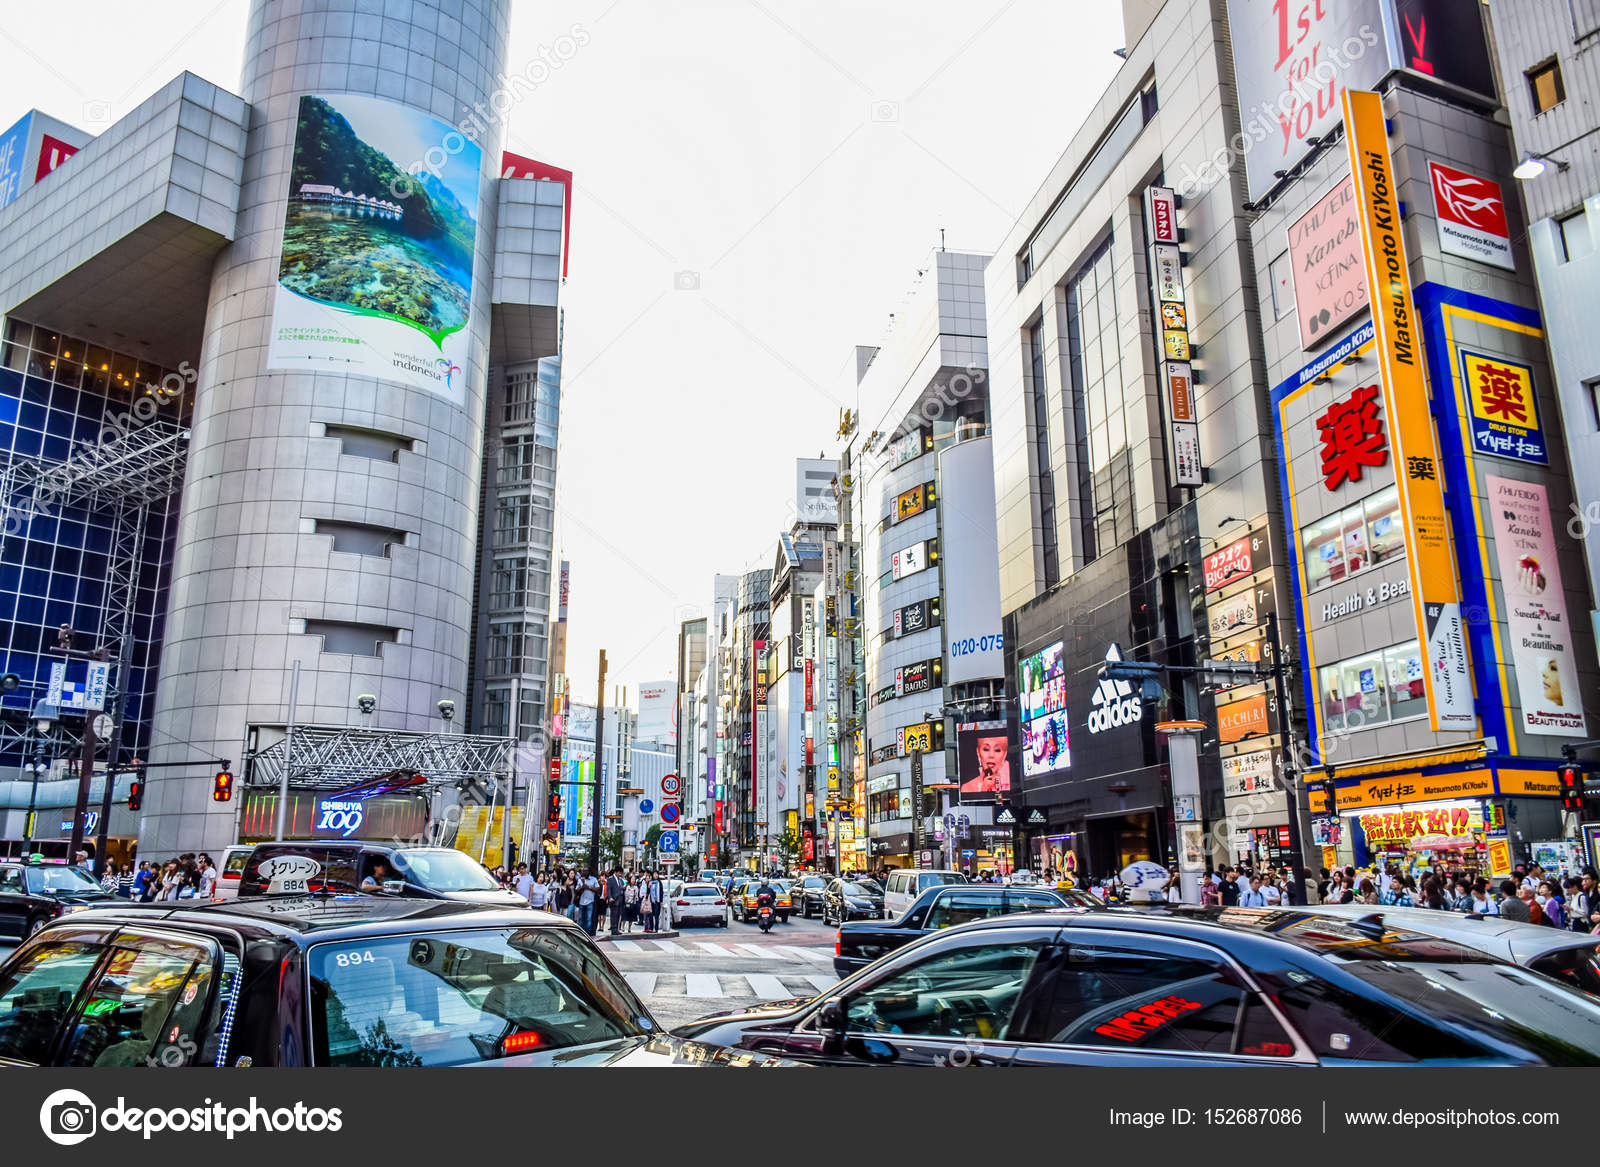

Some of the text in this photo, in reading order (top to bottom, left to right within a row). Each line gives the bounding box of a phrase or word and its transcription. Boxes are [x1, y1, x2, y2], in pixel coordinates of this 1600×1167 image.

[1273, 0, 1326, 72] 1st
[1288, 41, 1320, 93] for
[1156, 201, 1170, 237] カラオケ
[1304, 216, 1359, 273] Kaneb
[1442, 226, 1509, 252] Matsumoto KiYoshi
[1461, 239, 1493, 257] Holdings
[1369, 152, 1414, 366] Matsumoto KiYoshi
[393, 358, 442, 381] indonesia
[394, 352, 433, 369] wonderful
[1299, 342, 1352, 385] Matsumoto
[1477, 363, 1528, 423] 薬
[1316, 384, 1388, 491] 薬
[1489, 422, 1528, 437] DRUG STORE
[1408, 456, 1435, 481] 薬
[1497, 485, 1540, 502] SHISEIDO
[1507, 524, 1542, 539] Kanebo
[1211, 543, 1242, 569] カラオケ
[1206, 555, 1251, 587] BIG ECHO
[1322, 593, 1364, 622] Health
[1366, 587, 1377, 605] &
[1427, 604, 1440, 618] 4F
[1450, 616, 1466, 674] Beautilism
[1522, 638, 1564, 652] Beautilism
[905, 679, 928, 693] BAGUS
[1088, 696, 1142, 734] adidas
[1527, 713, 1584, 729] BEAUTY SALON
[665, 779, 677, 790] 30
[1424, 780, 1488, 795] Matsumoto KiYoshi
[321, 801, 363, 811] SHIBUYA
[316, 809, 363, 837] 109
[664, 836, 672, 850] P
[276, 861, 313, 876] グリーン
[336, 951, 375, 967] 894
